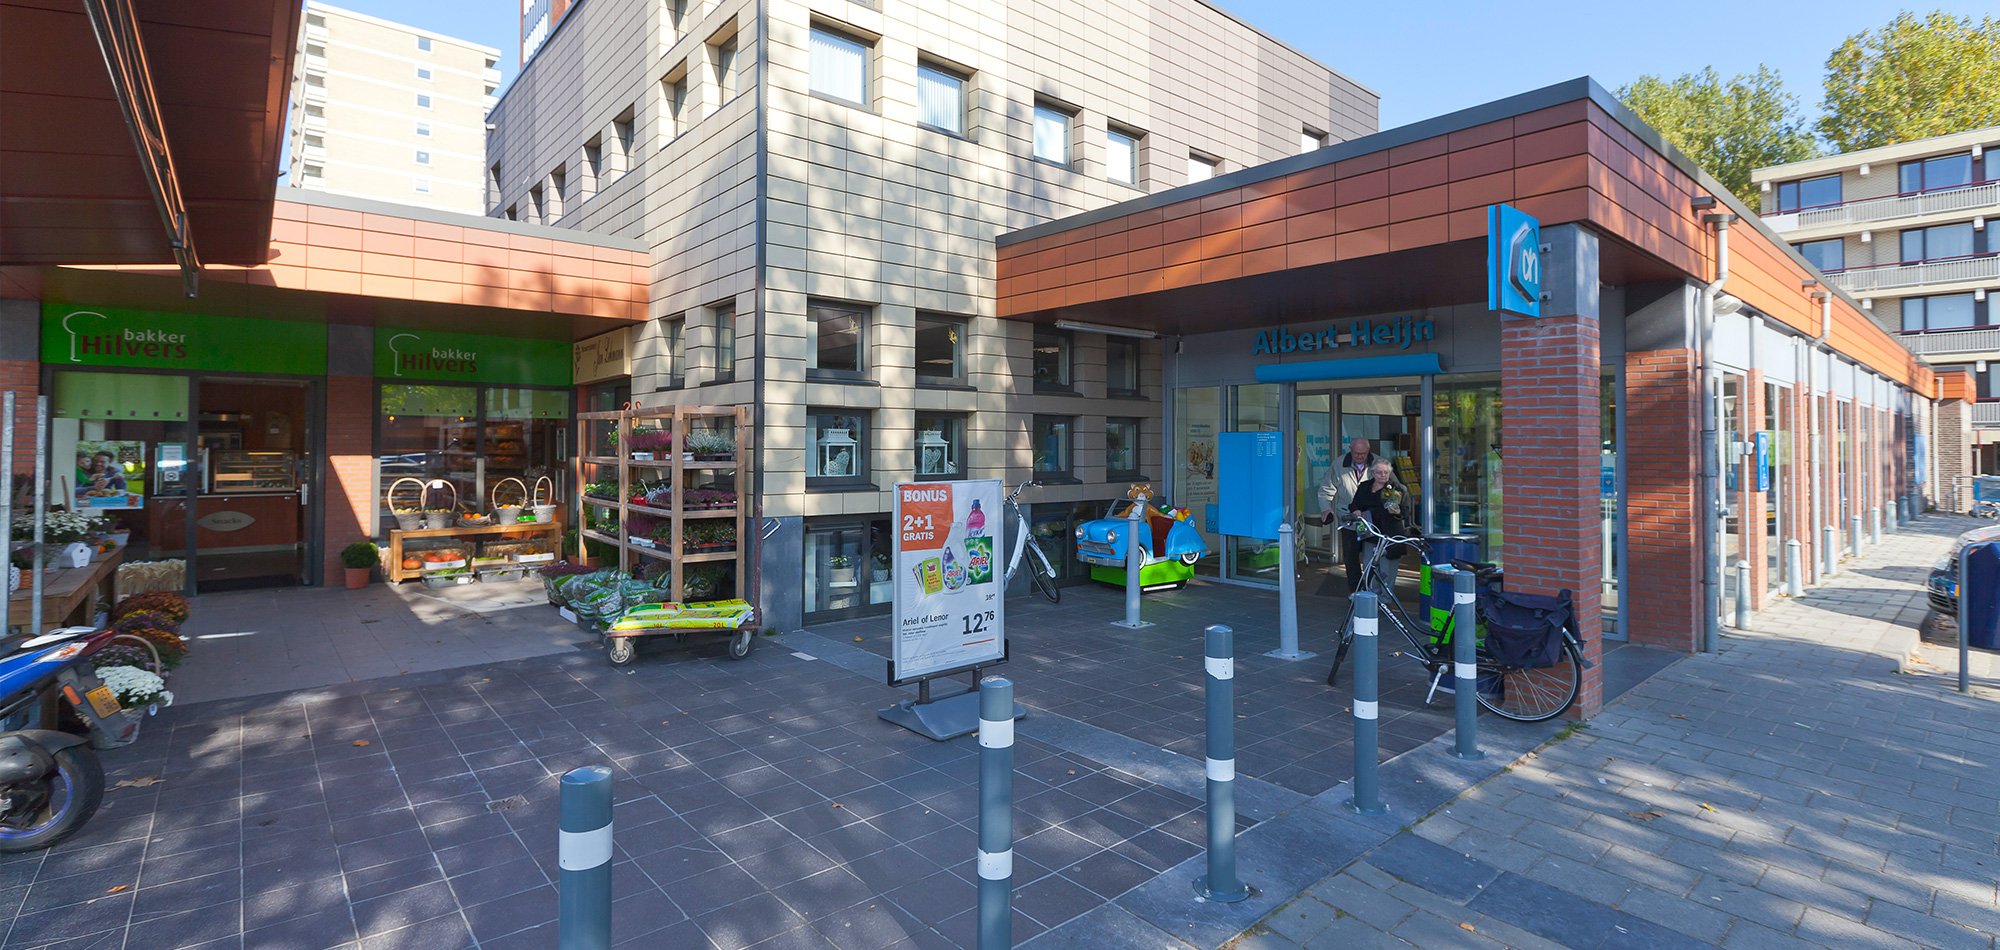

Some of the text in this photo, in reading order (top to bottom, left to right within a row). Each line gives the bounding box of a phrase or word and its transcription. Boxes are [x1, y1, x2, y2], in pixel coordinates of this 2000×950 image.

[124, 328, 186, 343] bakker
[1252, 315, 1435, 355] Albert Heijn
[81, 334, 187, 359] Hilvers
[432, 347, 477, 360] bakker
[402, 353, 478, 374] Hilvers
[903, 490, 948, 502] BONUS
[903, 514, 935, 531] 2+1
[903, 532, 935, 541] GRATIS
[902, 613, 949, 627] Ariel of Lenor
[962, 610, 995, 635] 12.76
